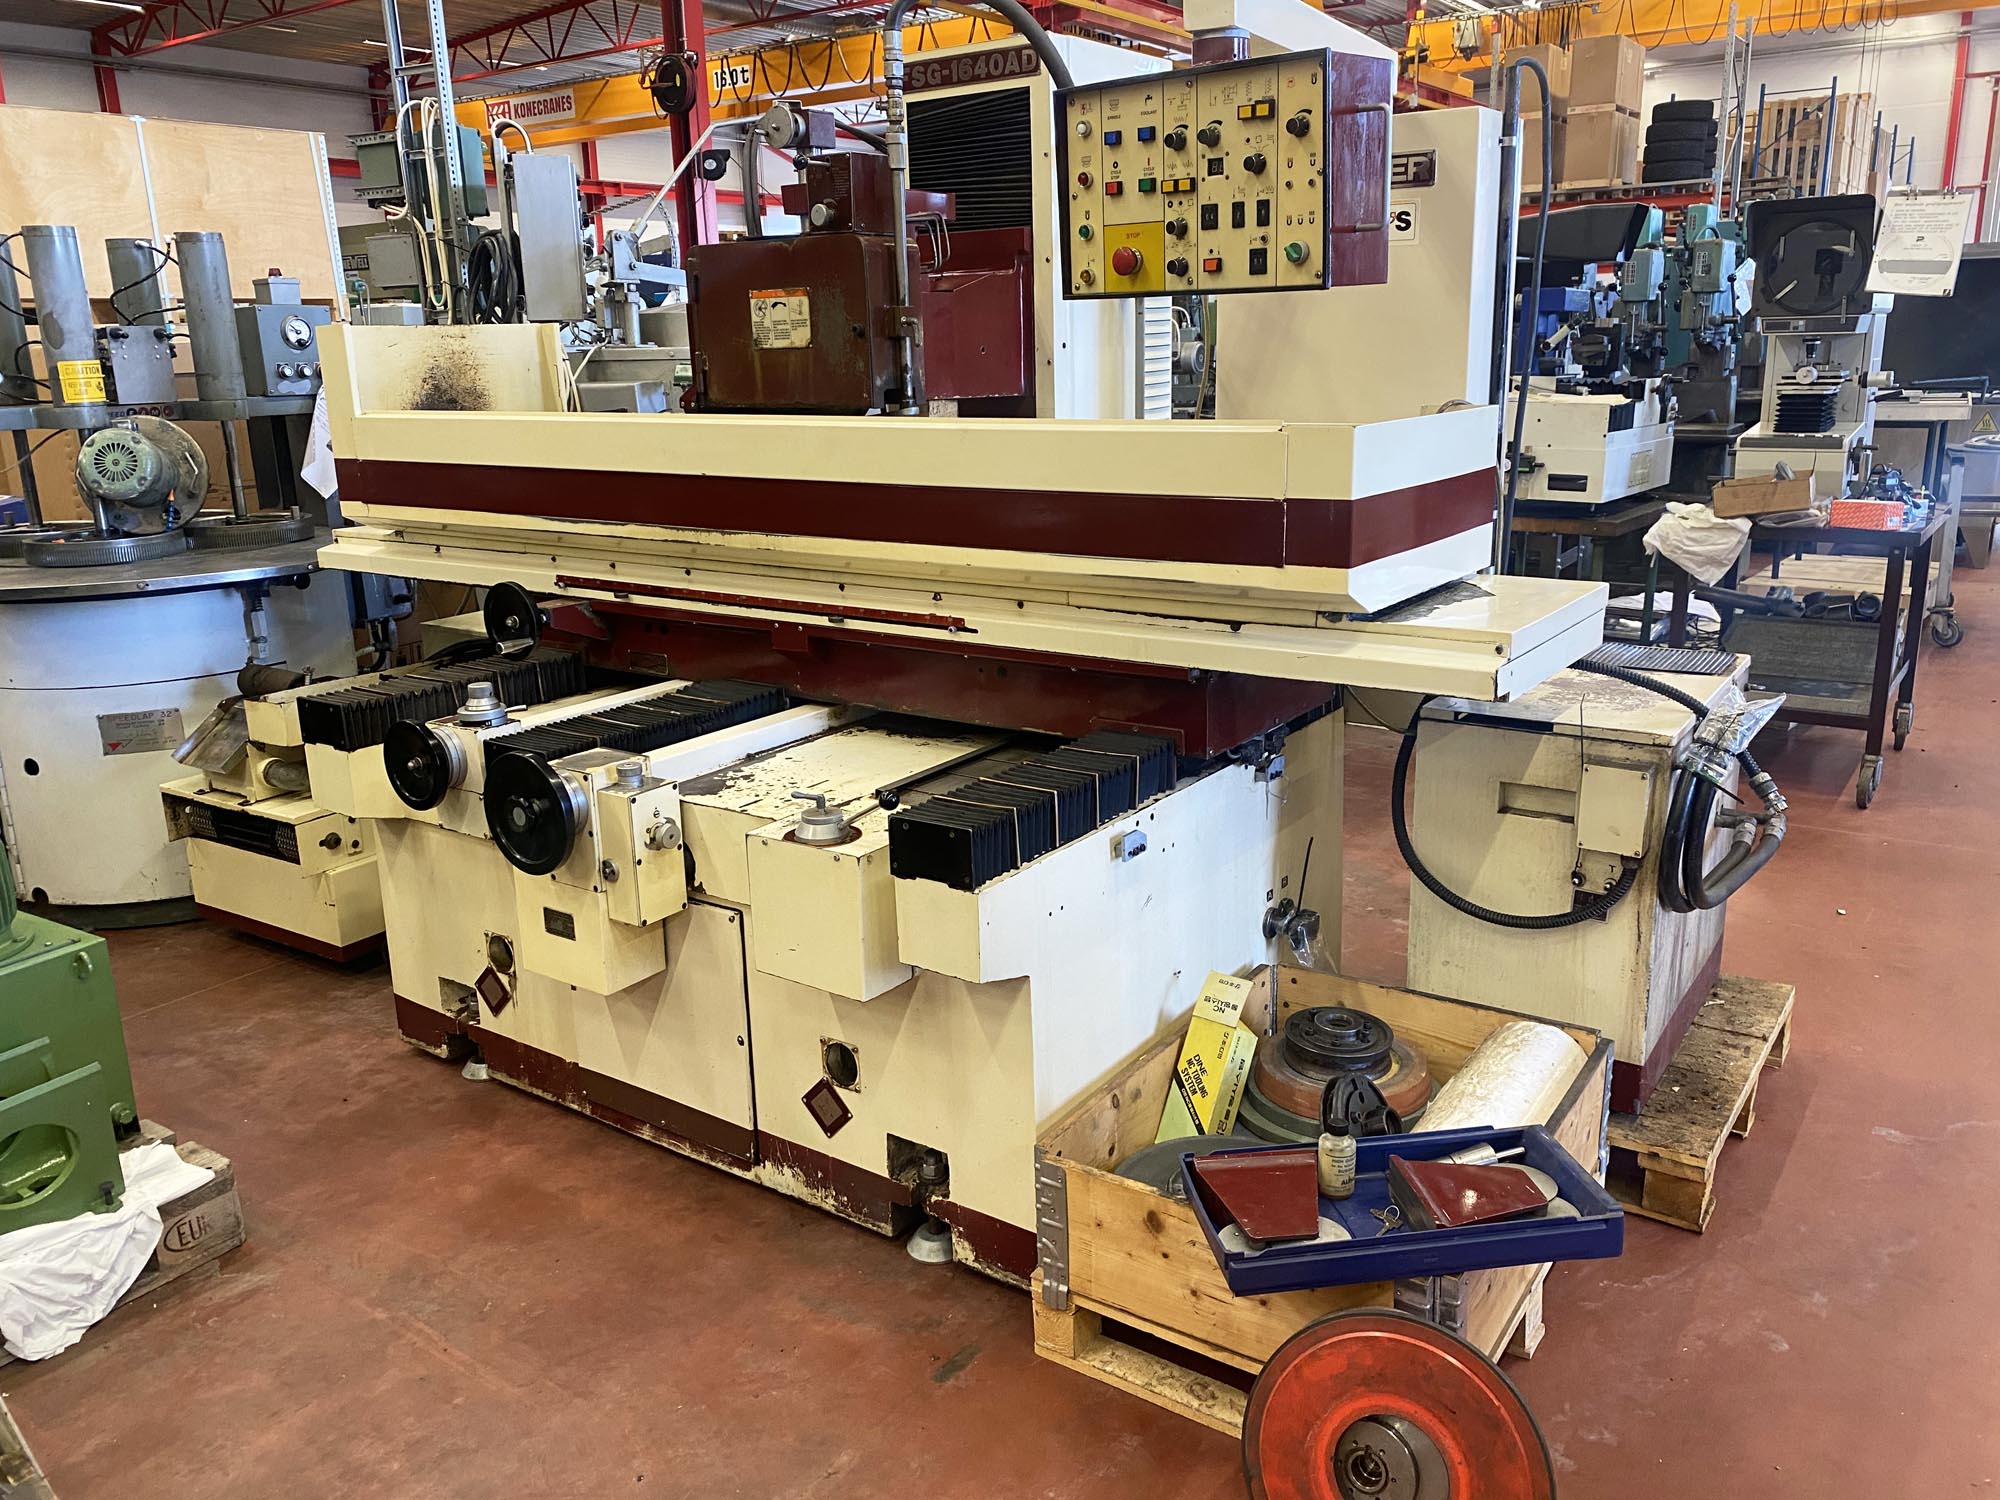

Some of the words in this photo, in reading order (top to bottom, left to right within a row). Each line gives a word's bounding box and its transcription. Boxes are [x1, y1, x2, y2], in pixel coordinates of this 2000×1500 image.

[513, 95, 573, 119] KONECRANES
[160, 710, 172, 718] 32
[1608, 864, 1617, 873] T
[1212, 1005, 1226, 1014] NC
[1193, 1053, 1208, 1077] DINE
[1181, 1067, 1198, 1097] SYSTEM
[1185, 1058, 1196, 1070] NC
[1191, 1068, 1209, 1099] TOOLING
